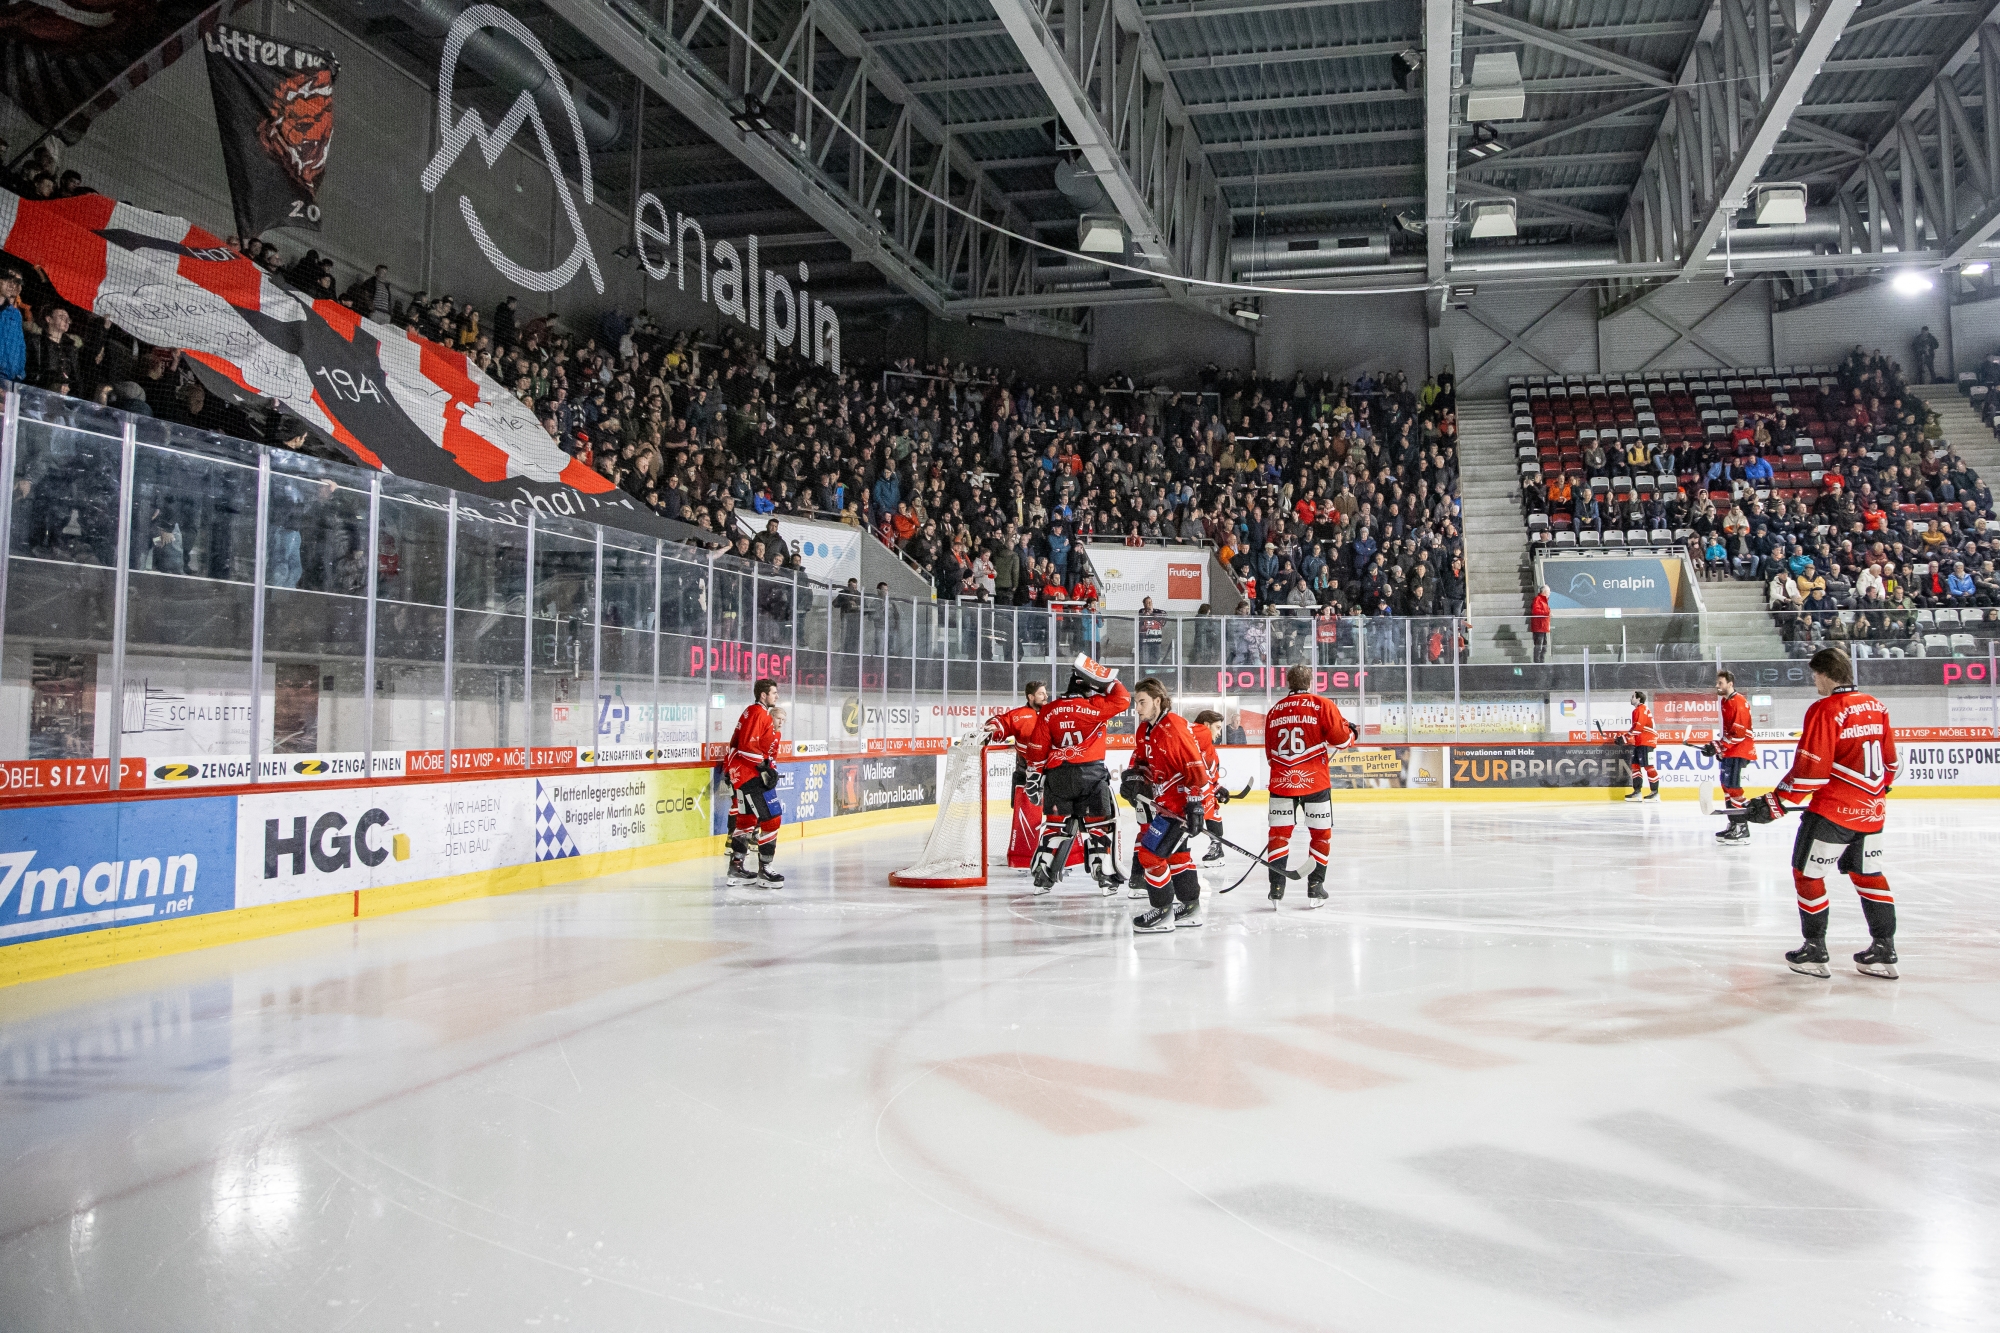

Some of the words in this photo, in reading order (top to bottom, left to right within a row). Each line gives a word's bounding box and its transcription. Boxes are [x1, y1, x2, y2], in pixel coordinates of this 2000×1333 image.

[635, 192, 841, 376] enalpin
[1169, 568, 1200, 579] Frutiger
[1602, 576, 1655, 591] enalpin
[1217, 667, 1369, 692] polliger
[1664, 701, 1683, 712] die
[1060, 721, 1076, 729] RITZ
[1939, 728, 1968, 736] MÖBEL
[1062, 731, 1084, 747] 41
[1277, 727, 1306, 755] 26
[503, 749, 535, 765] MÖBL
[537, 750, 554, 764] SIZ
[555, 750, 573, 764] VISP
[601, 750, 643, 762] ZENGAFFINEN
[663, 748, 700, 759] ZENGAFFINEN
[1339, 753, 1392, 763] affenstarker
[1517, 748, 1535, 756] Holz
[1862, 740, 1881, 778] 10
[1909, 748, 1944, 764] AUTO
[201, 761, 287, 778] ZENGAFINEN
[331, 757, 401, 774] ZENGAFINEN
[411, 753, 444, 770] MÖBE
[451, 753, 471, 768] SIZ
[472, 752, 494, 768] VISP
[1366, 761, 1399, 771] Partner
[50, 766, 85, 786] SIZ
[91, 765, 130, 784] VIP
[809, 763, 828, 777] SOPO
[863, 763, 897, 780] Walliser
[1453, 759, 1634, 782] ZURBRIGGEN
[1693, 774, 1715, 782] ZUM
[1909, 769, 1934, 780] 3930
[1937, 769, 1959, 780] VISP
[553, 781, 646, 803] Plattenlegergeschäft
[805, 777, 823, 791] SOPO
[800, 790, 819, 804] SOPO
[863, 784, 925, 805] Kantonalbank
[445, 801, 464, 816] WIR
[466, 798, 501, 814] HABEN
[565, 806, 605, 826] Briggeler
[606, 805, 632, 818] Martin
[633, 803, 646, 816] AG
[796, 804, 815, 819] SOPO
[445, 820, 476, 836] ALLES
[477, 816, 497, 832] FÜR
[611, 821, 646, 838] Brig-Glis
[264, 808, 391, 880] HGC
[445, 842, 467, 857] DEN
[159, 898, 194, 914] .net
